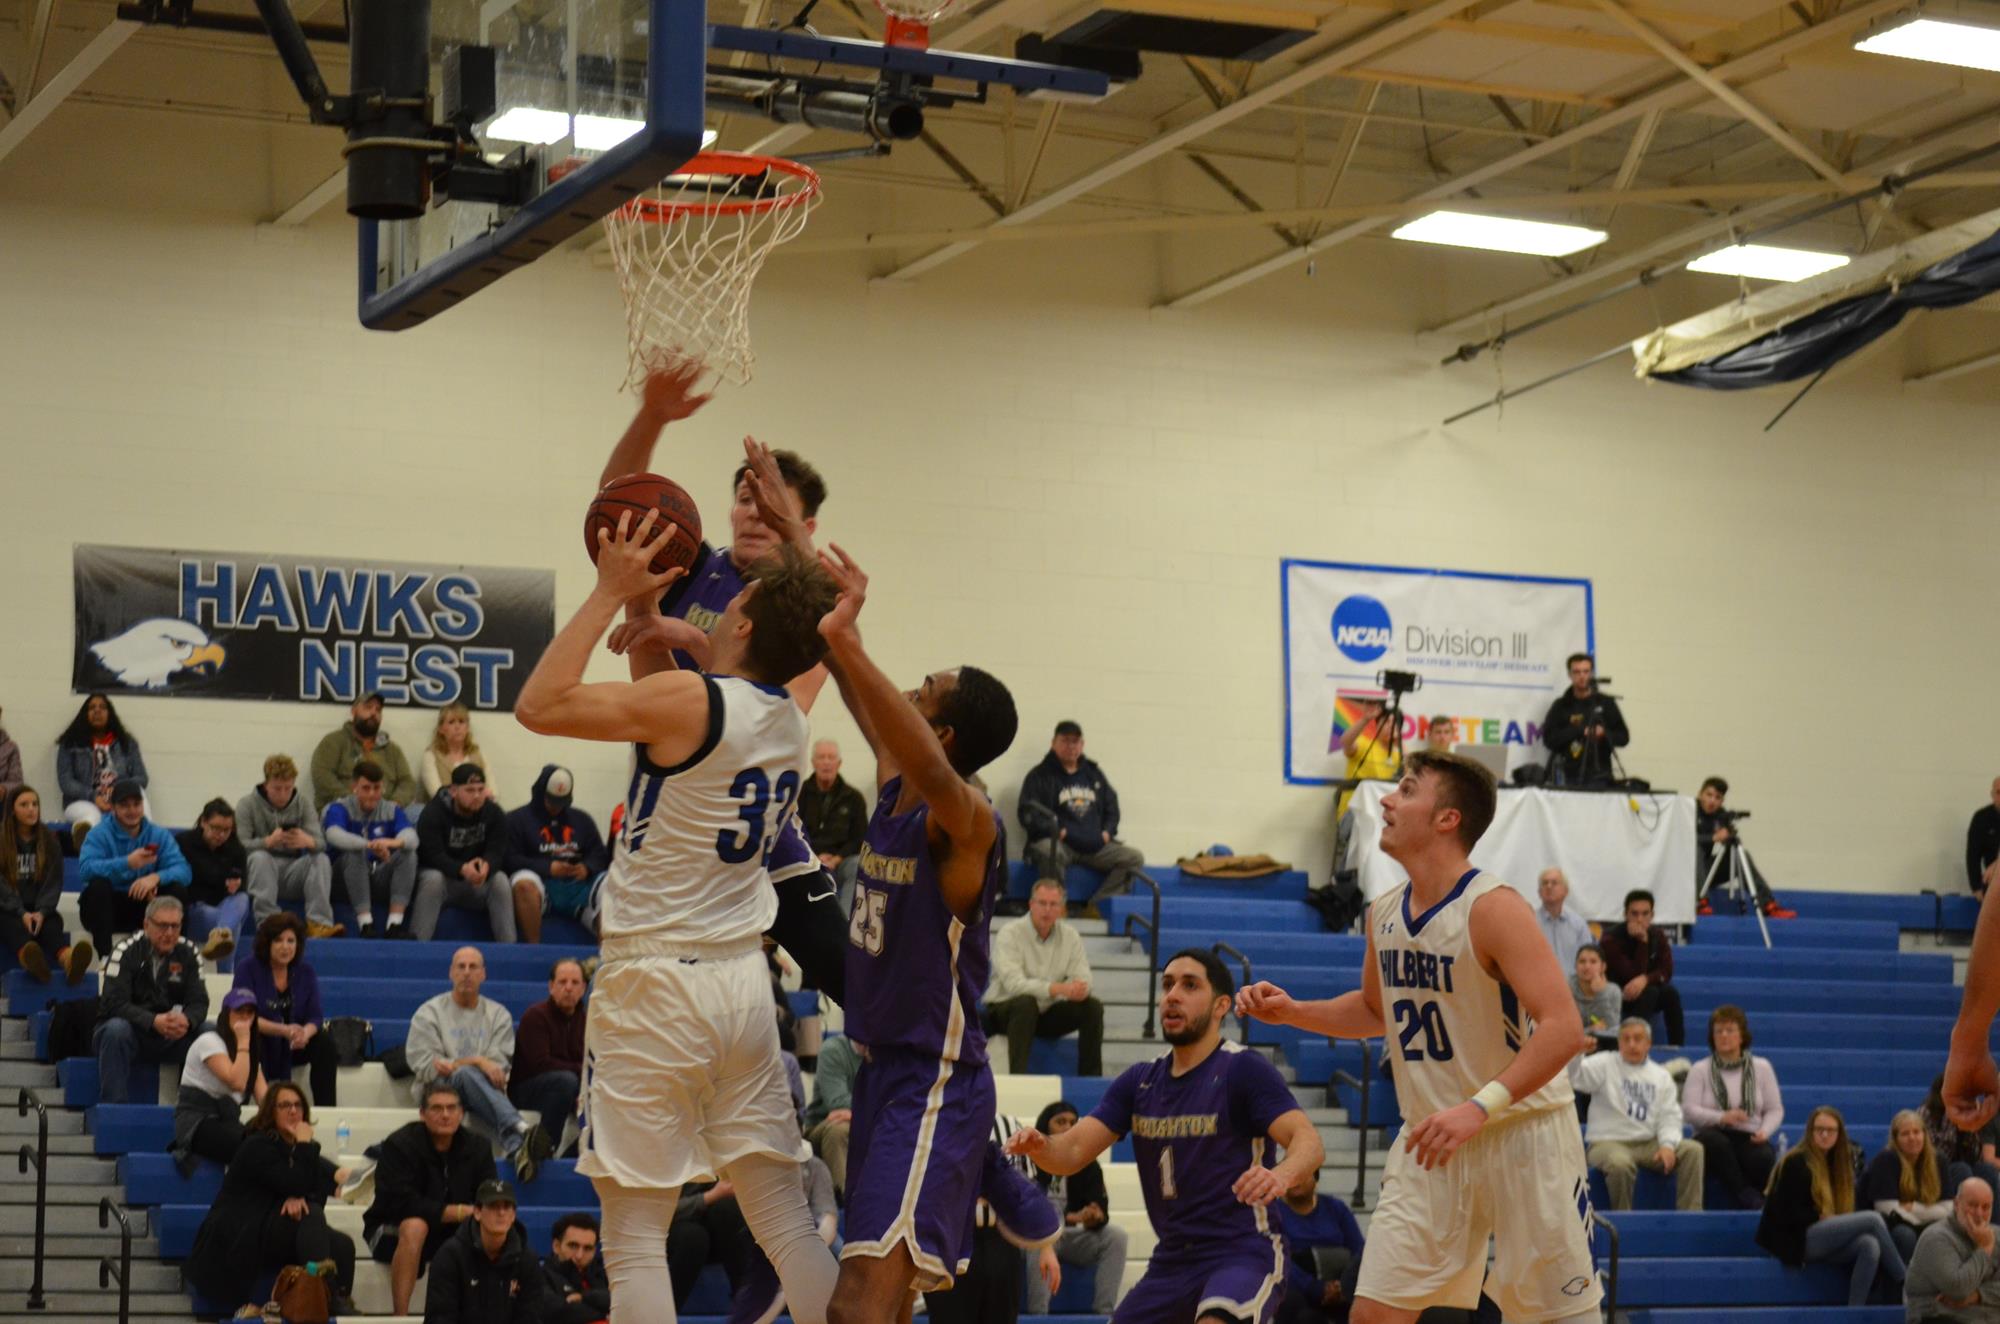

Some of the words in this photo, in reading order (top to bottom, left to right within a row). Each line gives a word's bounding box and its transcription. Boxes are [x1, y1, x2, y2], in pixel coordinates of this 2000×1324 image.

[178, 559, 484, 641] HAWKS
[1337, 625, 1391, 648] NCAA
[1406, 625, 1503, 657] Division
[1512, 632, 1528, 659] III
[300, 639, 513, 708] NEST
[850, 880, 888, 957] 25
[1379, 949, 1455, 993] HILBERT
[1392, 999, 1454, 1062] 20
[1158, 1145, 1178, 1200] 1
